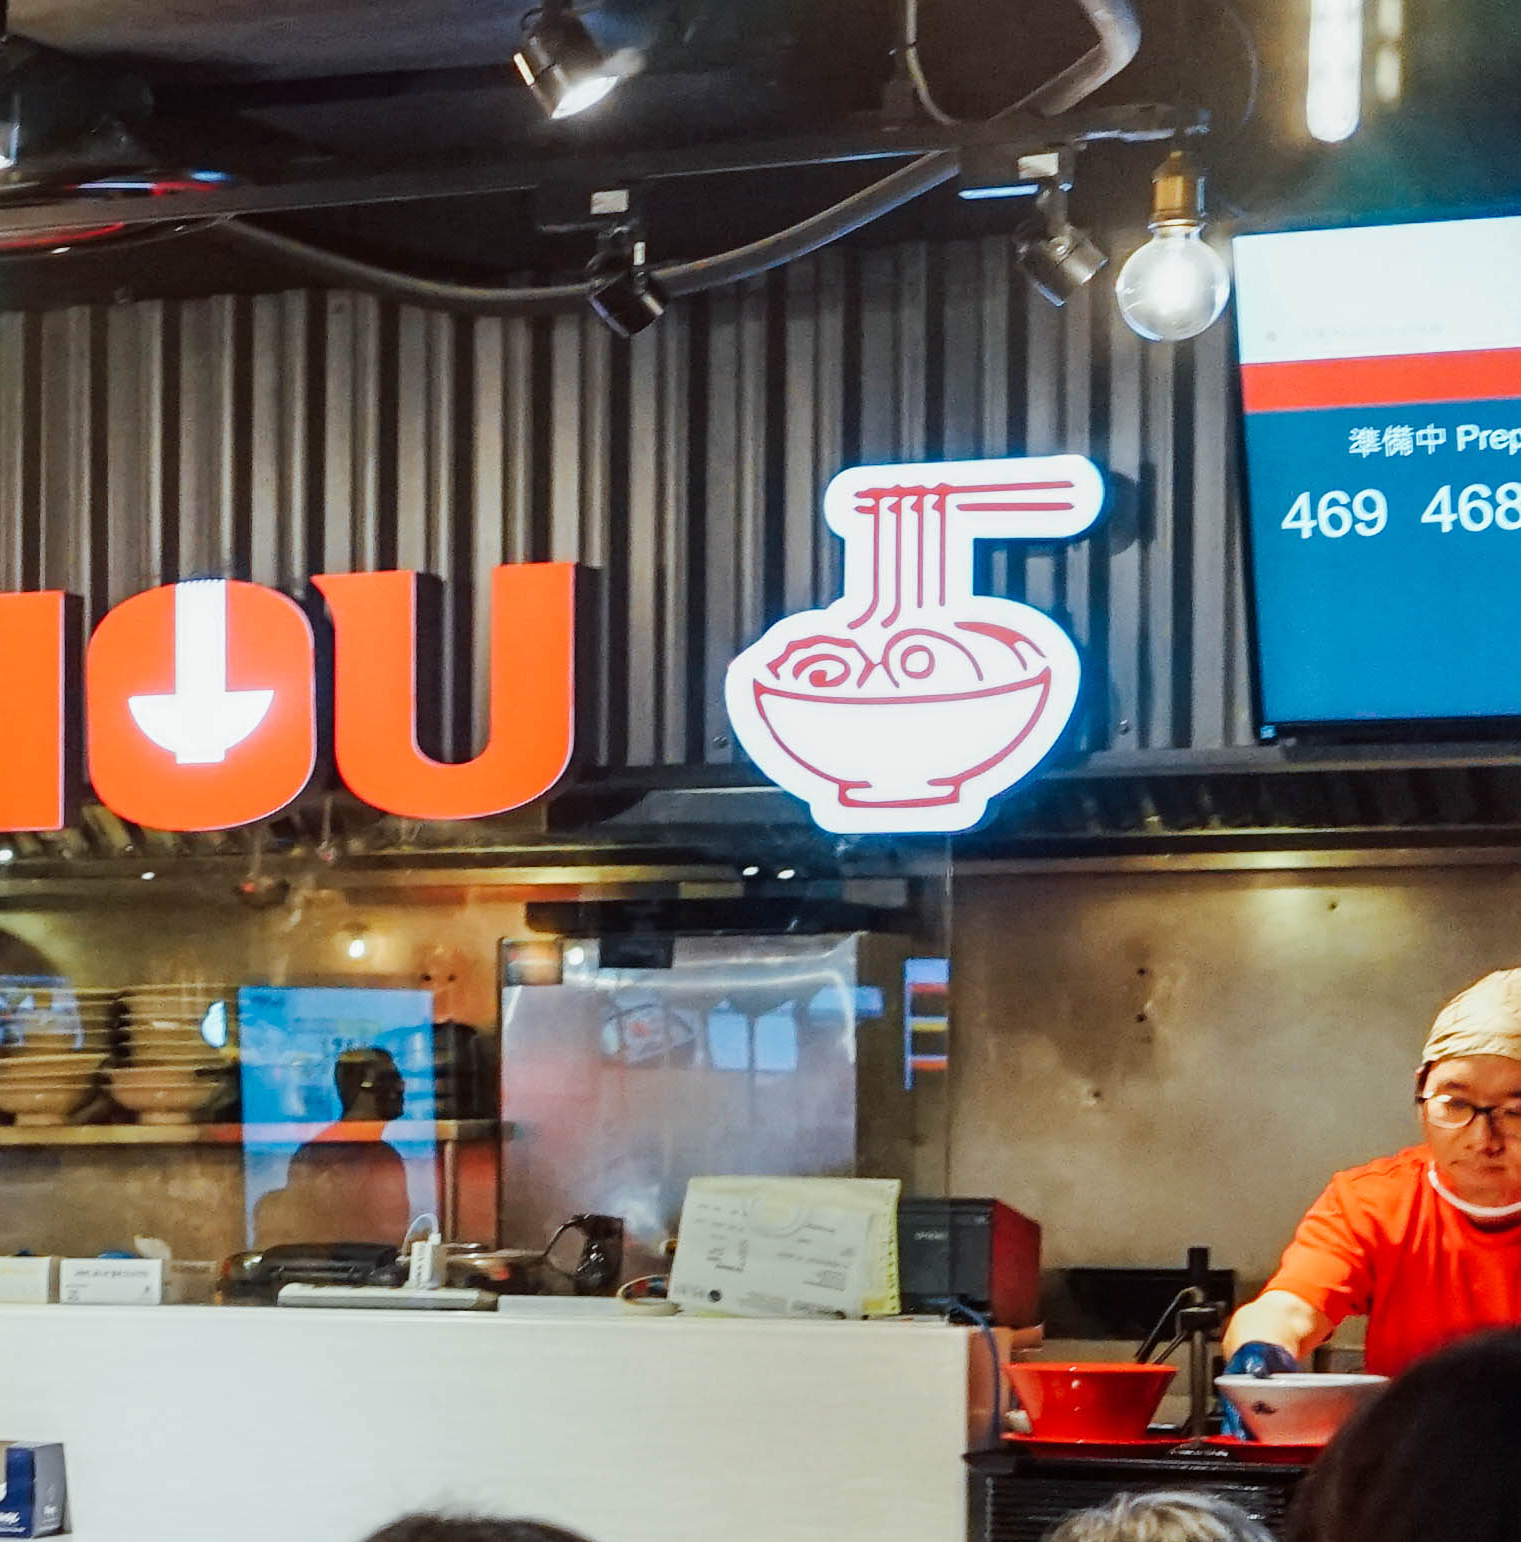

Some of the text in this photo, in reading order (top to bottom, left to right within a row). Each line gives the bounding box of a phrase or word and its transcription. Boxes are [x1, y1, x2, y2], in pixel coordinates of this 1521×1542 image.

[1348, 423, 1447, 458] 準備中
[1281, 482, 1521, 540] 469 468
